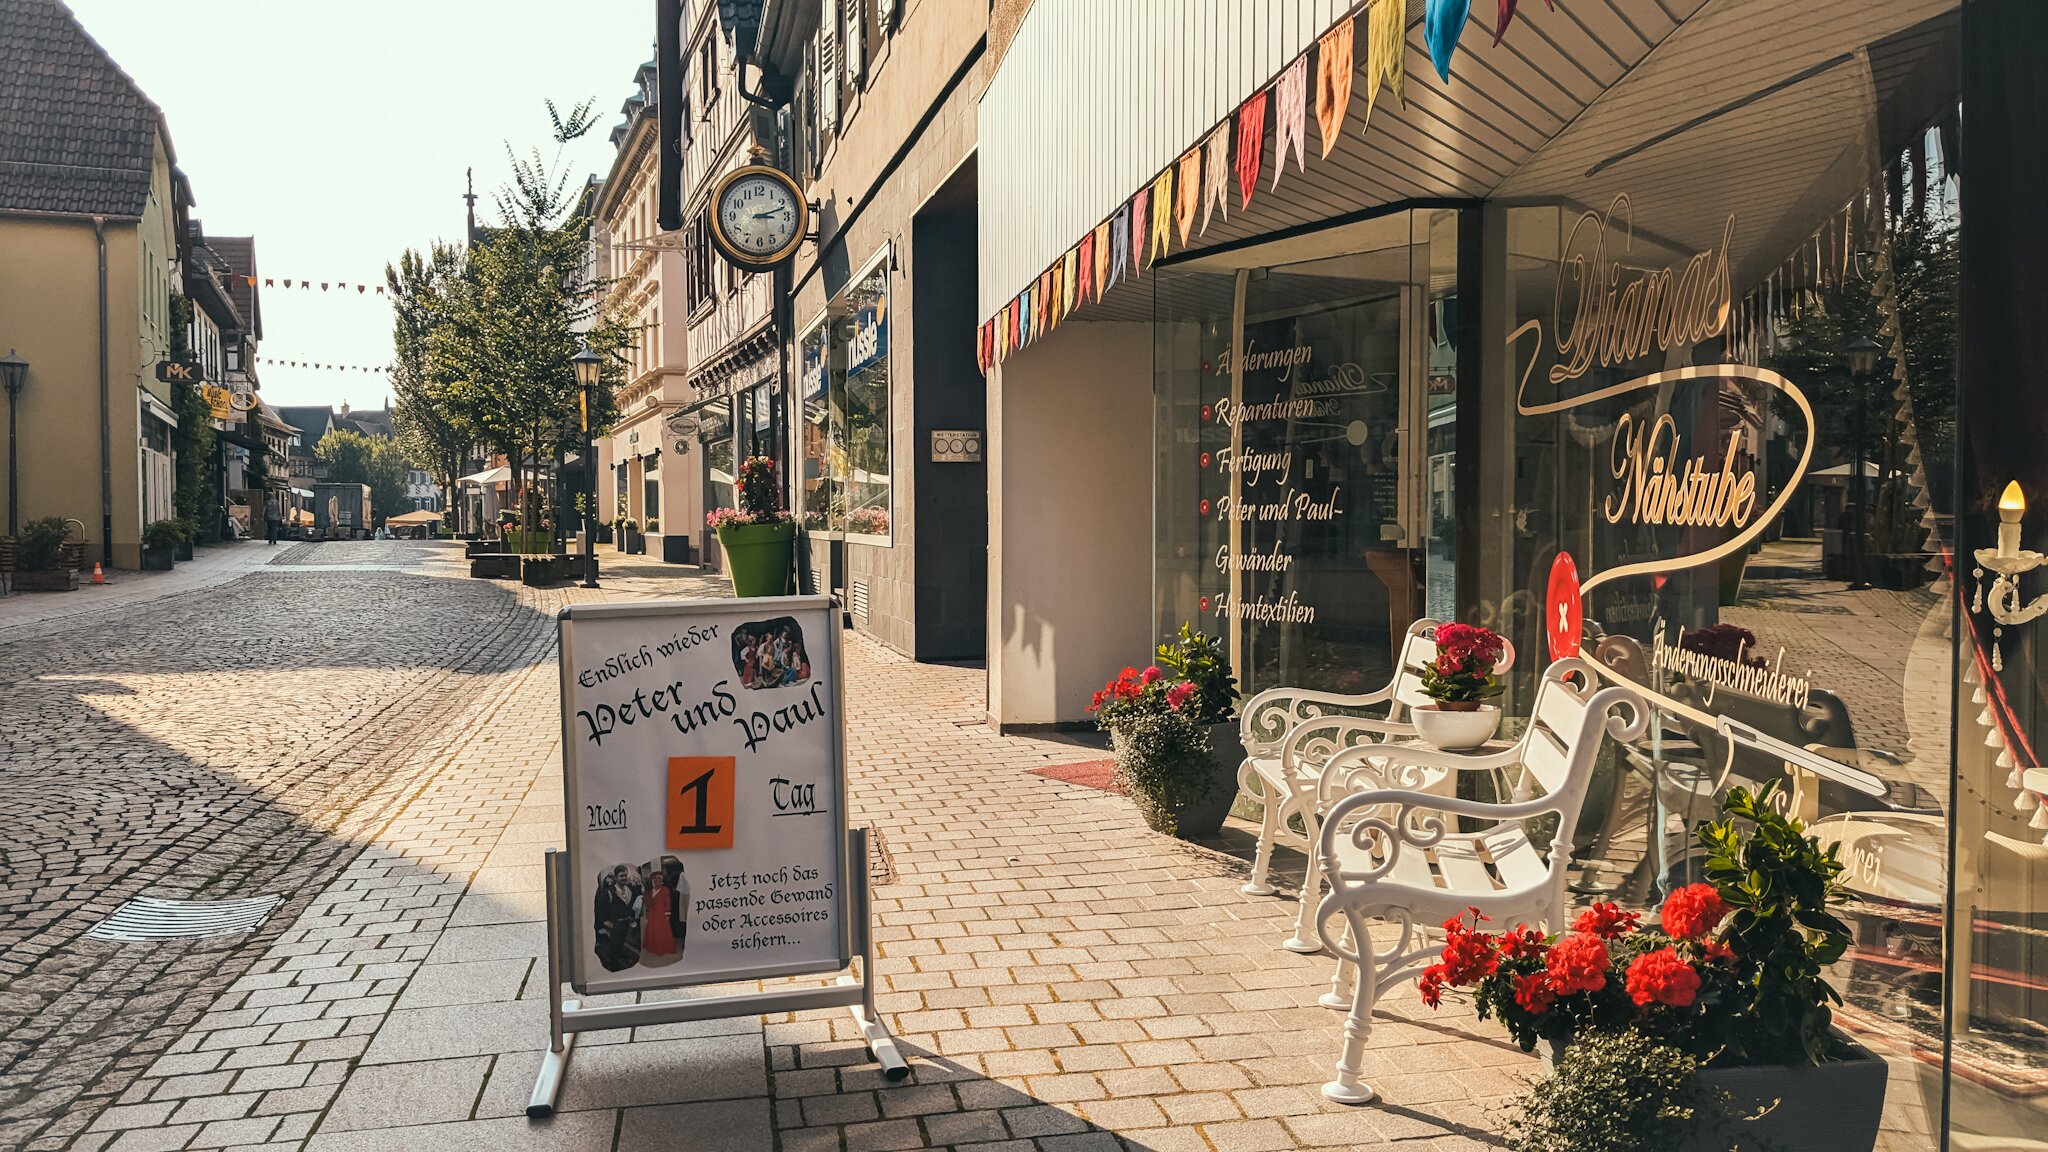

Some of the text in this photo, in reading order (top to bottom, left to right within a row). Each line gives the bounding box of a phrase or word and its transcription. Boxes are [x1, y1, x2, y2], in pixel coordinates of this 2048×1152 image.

[733, 198, 744, 209] 10
[743, 189, 752, 200] 11
[754, 185, 765, 197] 12
[769, 189, 774, 200] 1
[778, 198, 786, 209] 2
[729, 211, 736, 222] 9
[733, 223, 742, 235] 8
[779, 223, 785, 234] 4
[783, 211, 790, 222] 3
[743, 232, 752, 244] 7
[756, 237, 764, 248] 6
[768, 233, 776, 245] 5
[1549, 192, 1735, 383] Dianas
[1215, 340, 1312, 382] Änderungen
[1215, 393, 1315, 438] Reparaturen
[1215, 446, 1292, 487] Fertigung
[1605, 412, 1757, 528] Nähstube
[1216, 495, 1256, 522] Peter
[1258, 487, 1295, 522] und
[1215, 540, 1293, 574] Gewänder
[1214, 590, 1316, 627] Heimtextilien
[577, 624, 719, 688] Endlich wieder
[1652, 618, 1812, 711] Änderungsschneiderei
[577, 680, 826, 753] Peter und Paul
[586, 767, 816, 835] Noch 1 Tag
[709, 865, 819, 891] Jetzt noch das
[695, 883, 833, 913] passende Gewand
[702, 907, 829, 932] oder Accessoires
